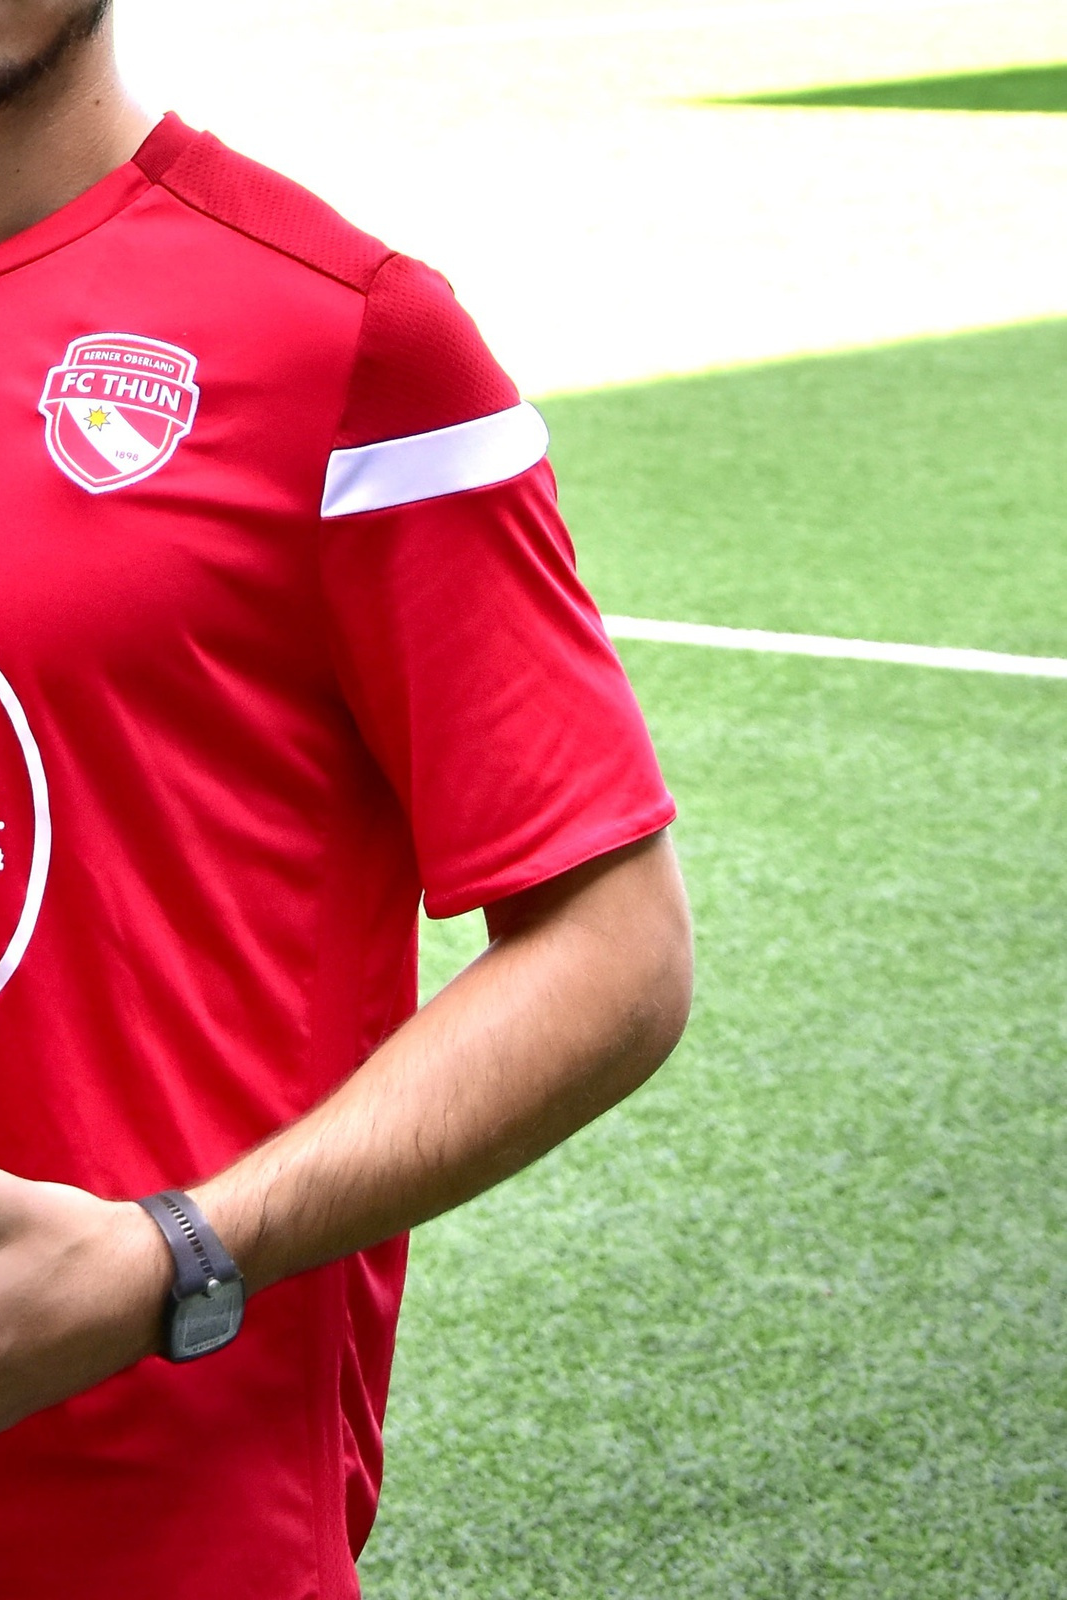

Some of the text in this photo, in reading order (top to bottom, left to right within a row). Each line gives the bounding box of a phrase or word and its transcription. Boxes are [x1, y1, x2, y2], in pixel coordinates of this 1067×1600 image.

[83, 351, 175, 373] BERNER OBERLAND
[60, 372, 182, 412] FC THUN
[114, 450, 139, 462] 1898
